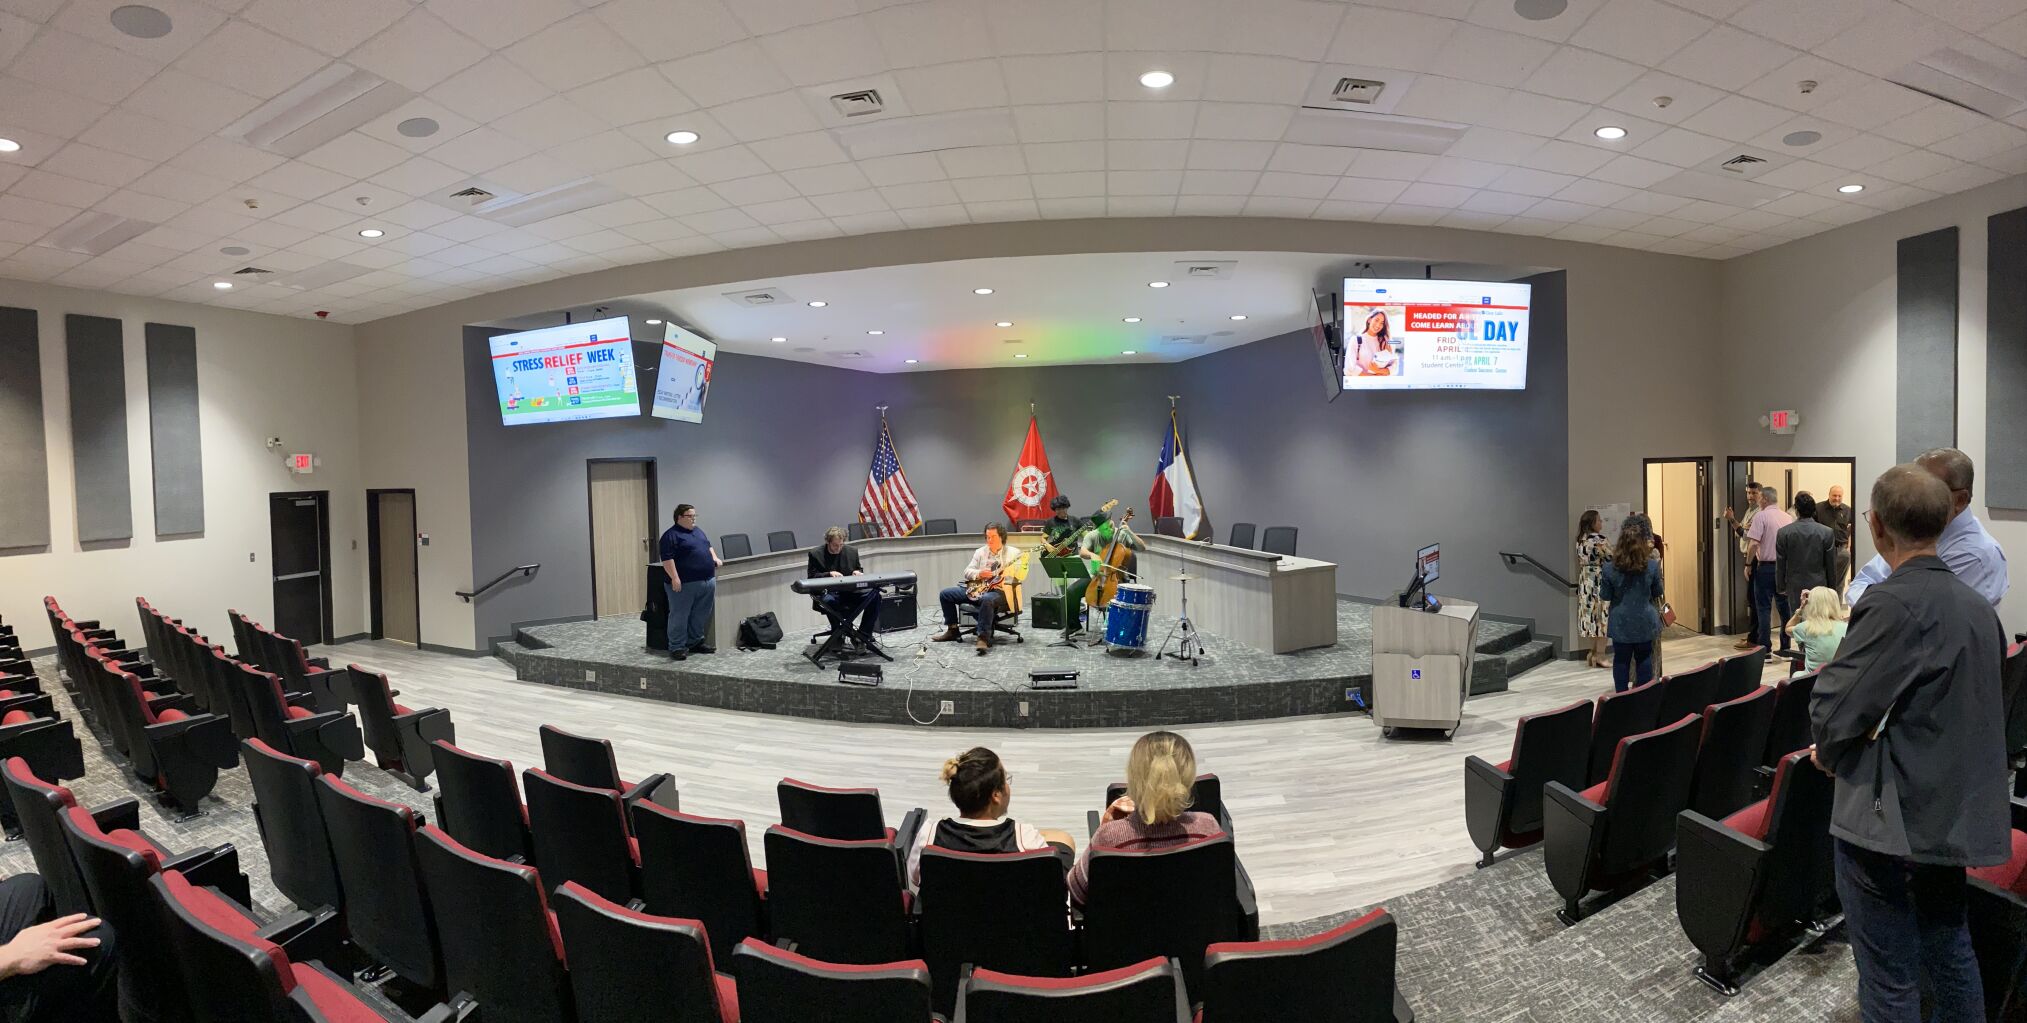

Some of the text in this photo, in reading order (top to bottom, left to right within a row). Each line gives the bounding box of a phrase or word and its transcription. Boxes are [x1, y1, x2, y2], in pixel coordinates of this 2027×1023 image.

[1484, 320, 1519, 341] DAY
[512, 357, 544, 372] STRESS
[544, 352, 583, 368] RELIEF
[587, 348, 615, 363] WEEK
[1474, 356, 1490, 365] APRIL
[1773, 412, 1788, 427] EXIT
[296, 455, 309, 467] EXIT
